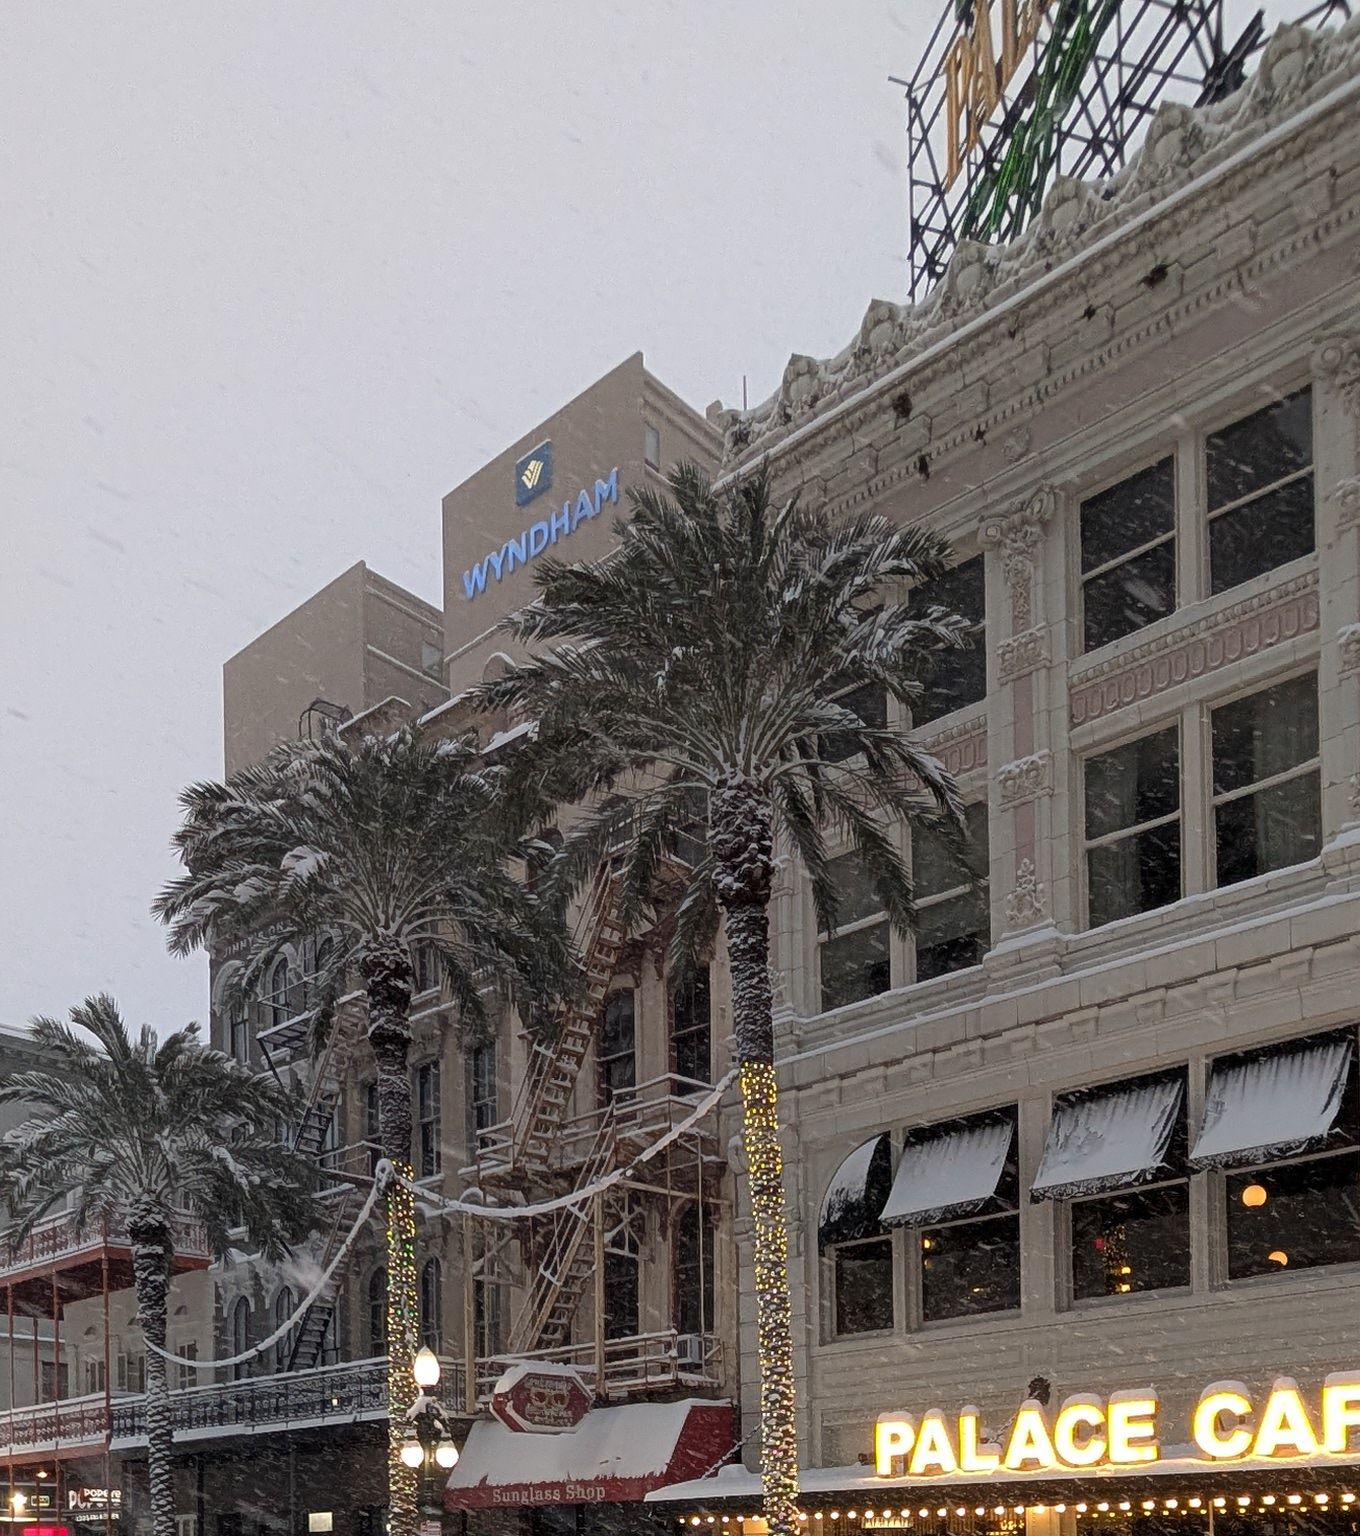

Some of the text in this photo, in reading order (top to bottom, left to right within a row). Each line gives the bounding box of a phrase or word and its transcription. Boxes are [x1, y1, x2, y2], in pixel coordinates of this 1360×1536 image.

[462, 467, 620, 600] WYNDHAM
[874, 1388, 1161, 1478] PALACE
[492, 1484, 606, 1504] Sunglass Shop
